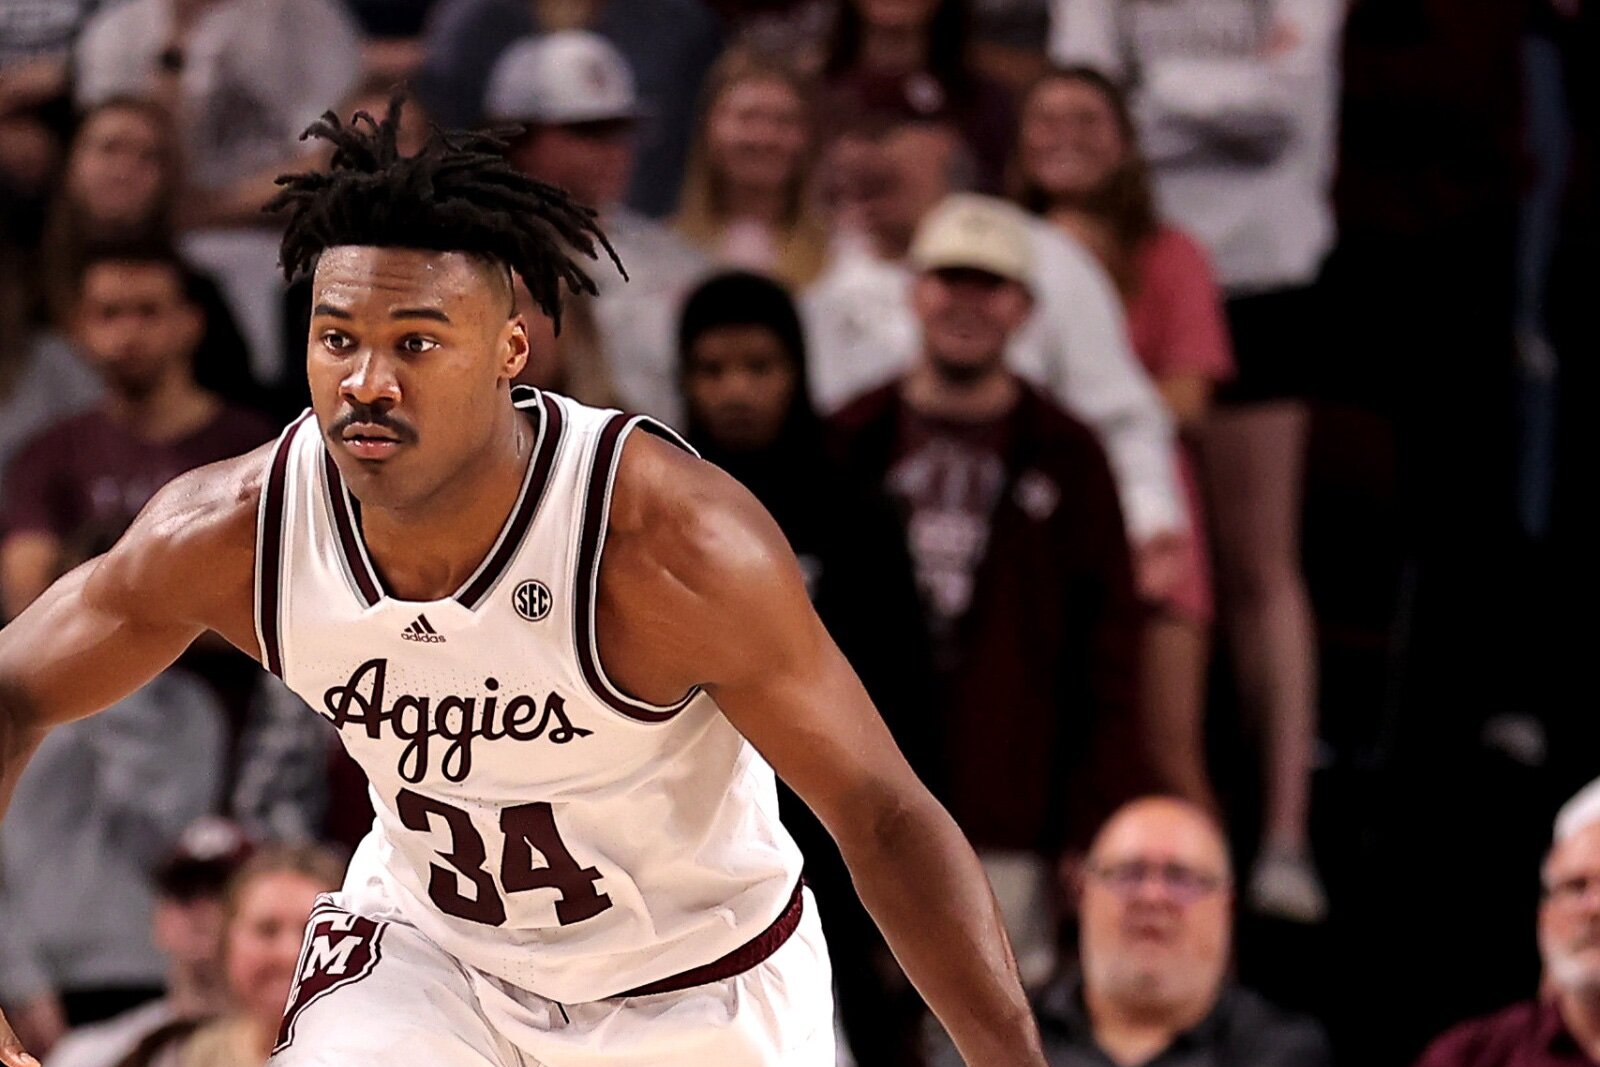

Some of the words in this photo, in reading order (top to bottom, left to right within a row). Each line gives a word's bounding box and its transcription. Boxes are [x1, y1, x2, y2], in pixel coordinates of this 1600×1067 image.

[400, 632, 446, 643] adidas
[517, 585, 549, 619] SEC
[324, 658, 594, 784] Aggies
[395, 787, 613, 927] 34
